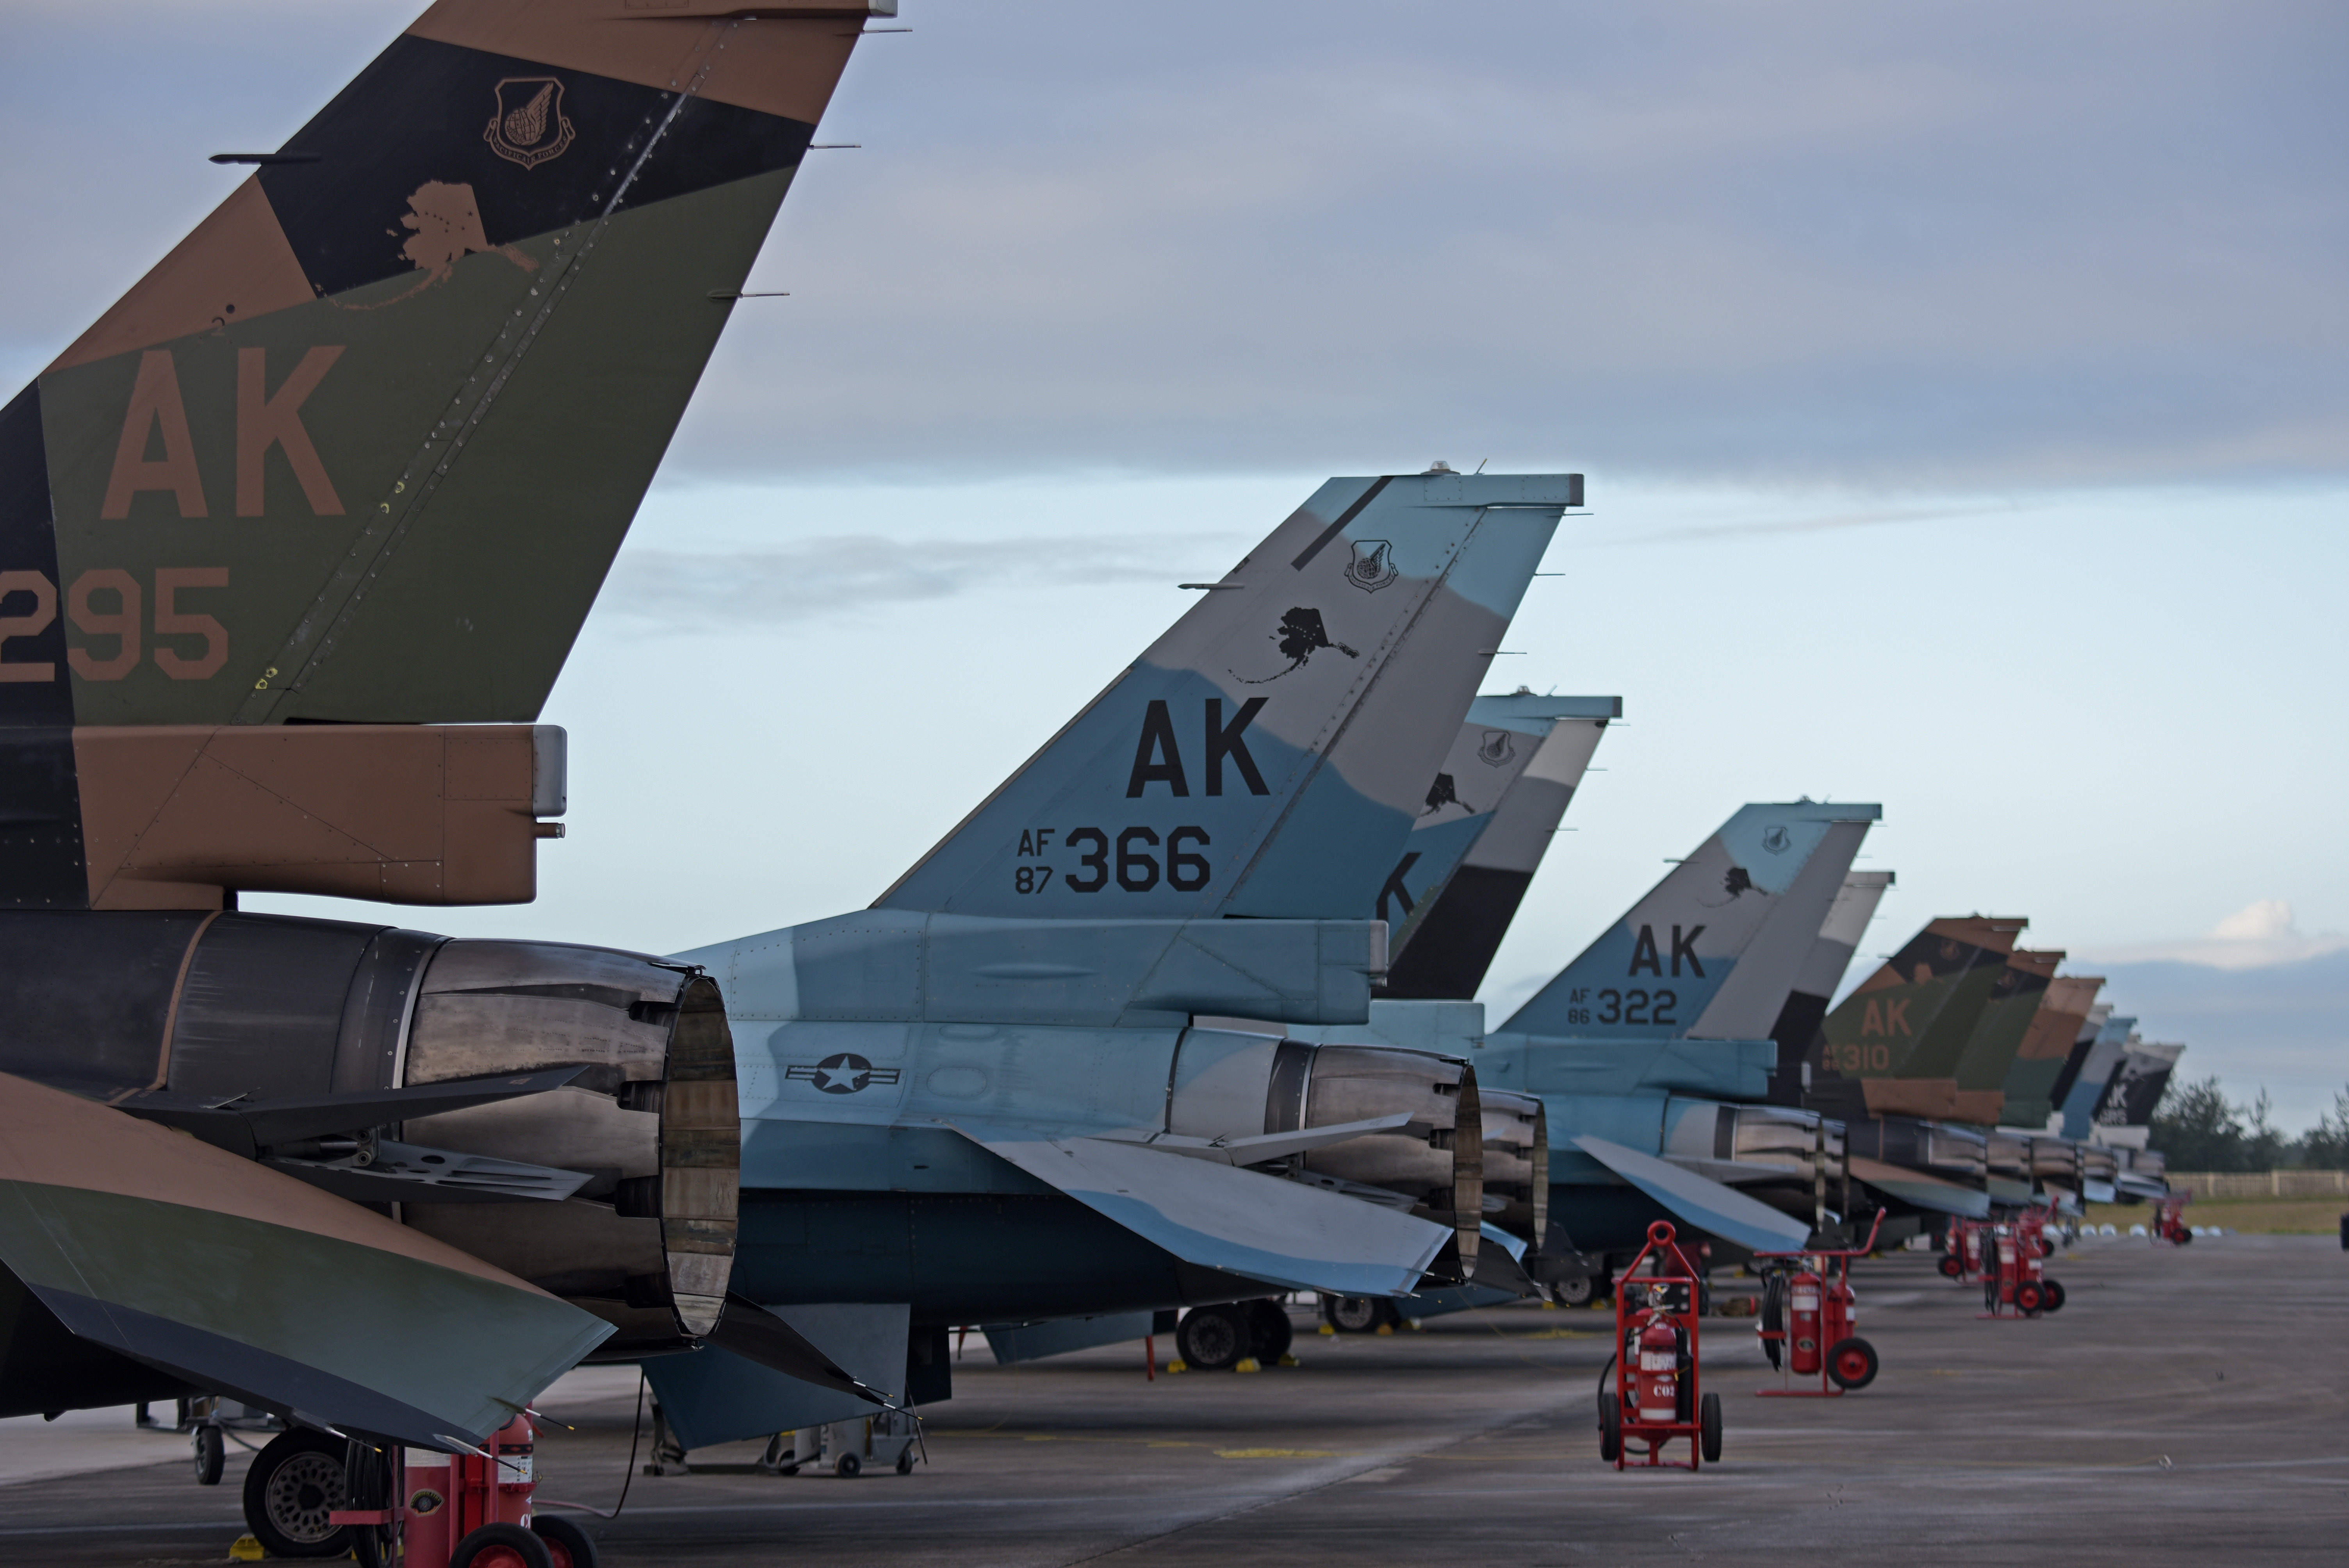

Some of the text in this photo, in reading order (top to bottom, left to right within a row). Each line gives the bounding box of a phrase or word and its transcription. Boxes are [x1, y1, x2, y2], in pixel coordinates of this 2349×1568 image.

[493, 137, 522, 159] PACIFIC
[538, 136, 567, 159] FORCES
[101, 345, 347, 519] AK
[0, 568, 229, 682] 295
[1126, 697, 1271, 798] AK
[1017, 829, 1055, 857] AF
[1066, 826, 1210, 893] 366
[1016, 866, 1053, 894] 87
[1628, 924, 1707, 979] AK
[1569, 988, 1591, 1004] AF
[1597, 988, 1677, 1025] 322
[1568, 1009, 1590, 1024] 86
[1861, 998, 1912, 1037] AK
[1843, 1044, 1889, 1071] 310
